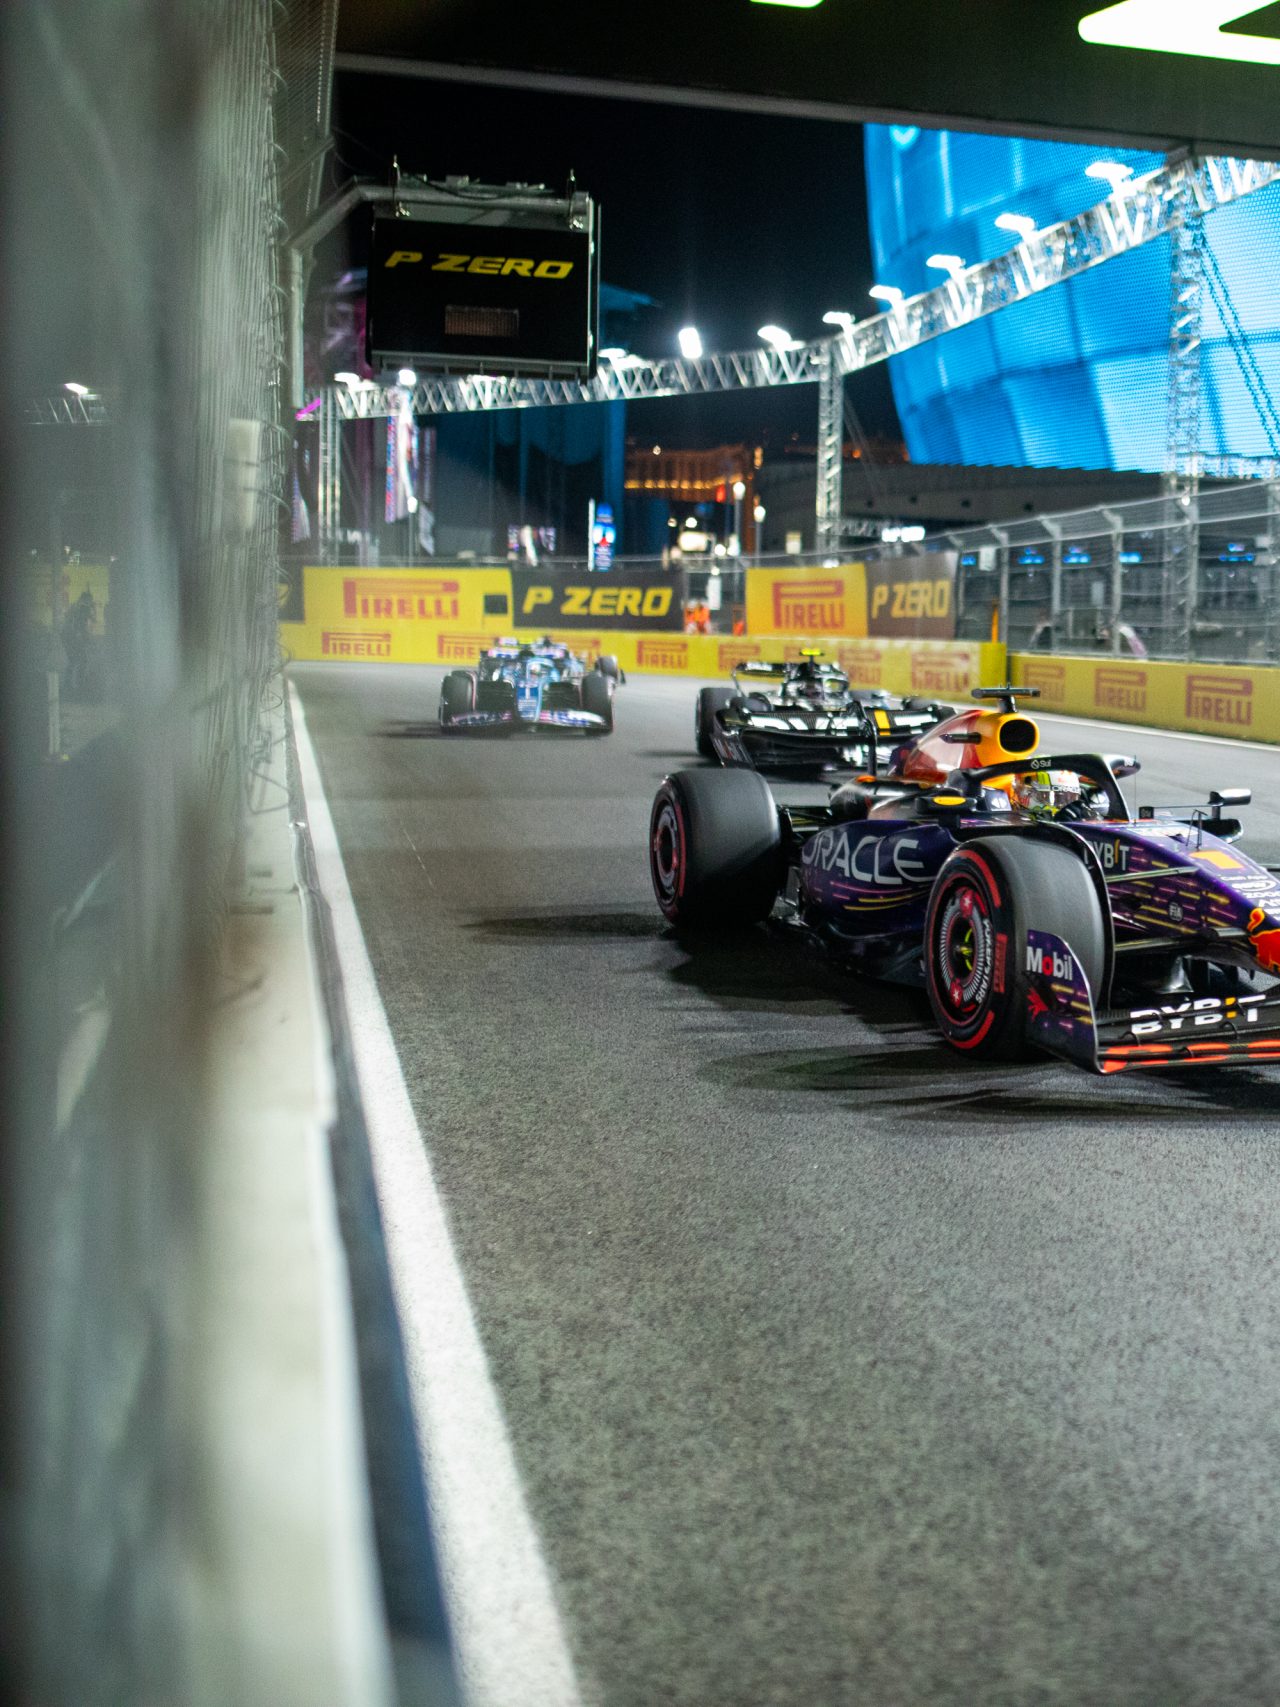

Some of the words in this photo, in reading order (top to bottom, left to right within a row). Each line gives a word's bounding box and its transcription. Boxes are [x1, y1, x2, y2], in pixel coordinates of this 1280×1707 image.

[384, 251, 423, 268] P
[431, 254, 574, 279] ZERO
[344, 577, 459, 619] PIRELLI
[523, 586, 553, 614] P
[560, 586, 673, 617] ZERO
[773, 580, 844, 629] PIRELLI
[872, 584, 888, 619] P
[891, 580, 951, 618] ZERO
[322, 632, 392, 656] PIRELLI
[636, 641, 689, 669] PIRELLI
[1095, 668, 1147, 712] PIRELLI
[1186, 675, 1253, 726] PIRELLI
[802, 831, 938, 884] ORACLE
[1026, 946, 1073, 981] Mobil
